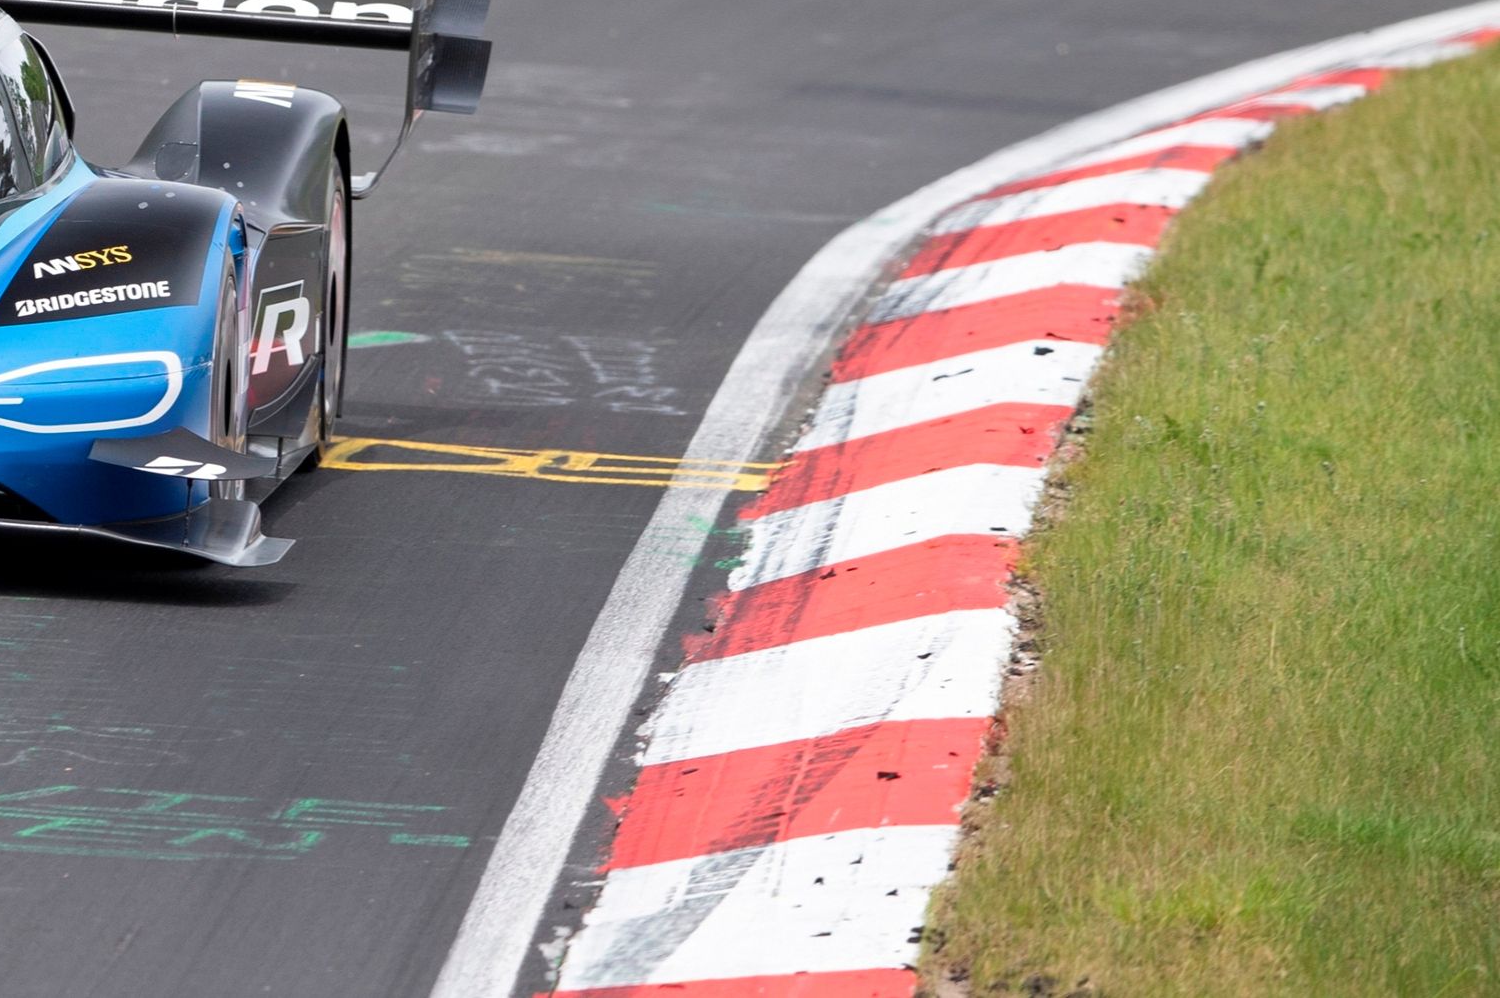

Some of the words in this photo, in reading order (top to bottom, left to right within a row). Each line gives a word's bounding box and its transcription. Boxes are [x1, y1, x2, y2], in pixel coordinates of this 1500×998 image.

[33, 246, 133, 279] ANSYS
[15, 280, 171, 317] BRIDGESTONE
[250, 280, 310, 375] R
